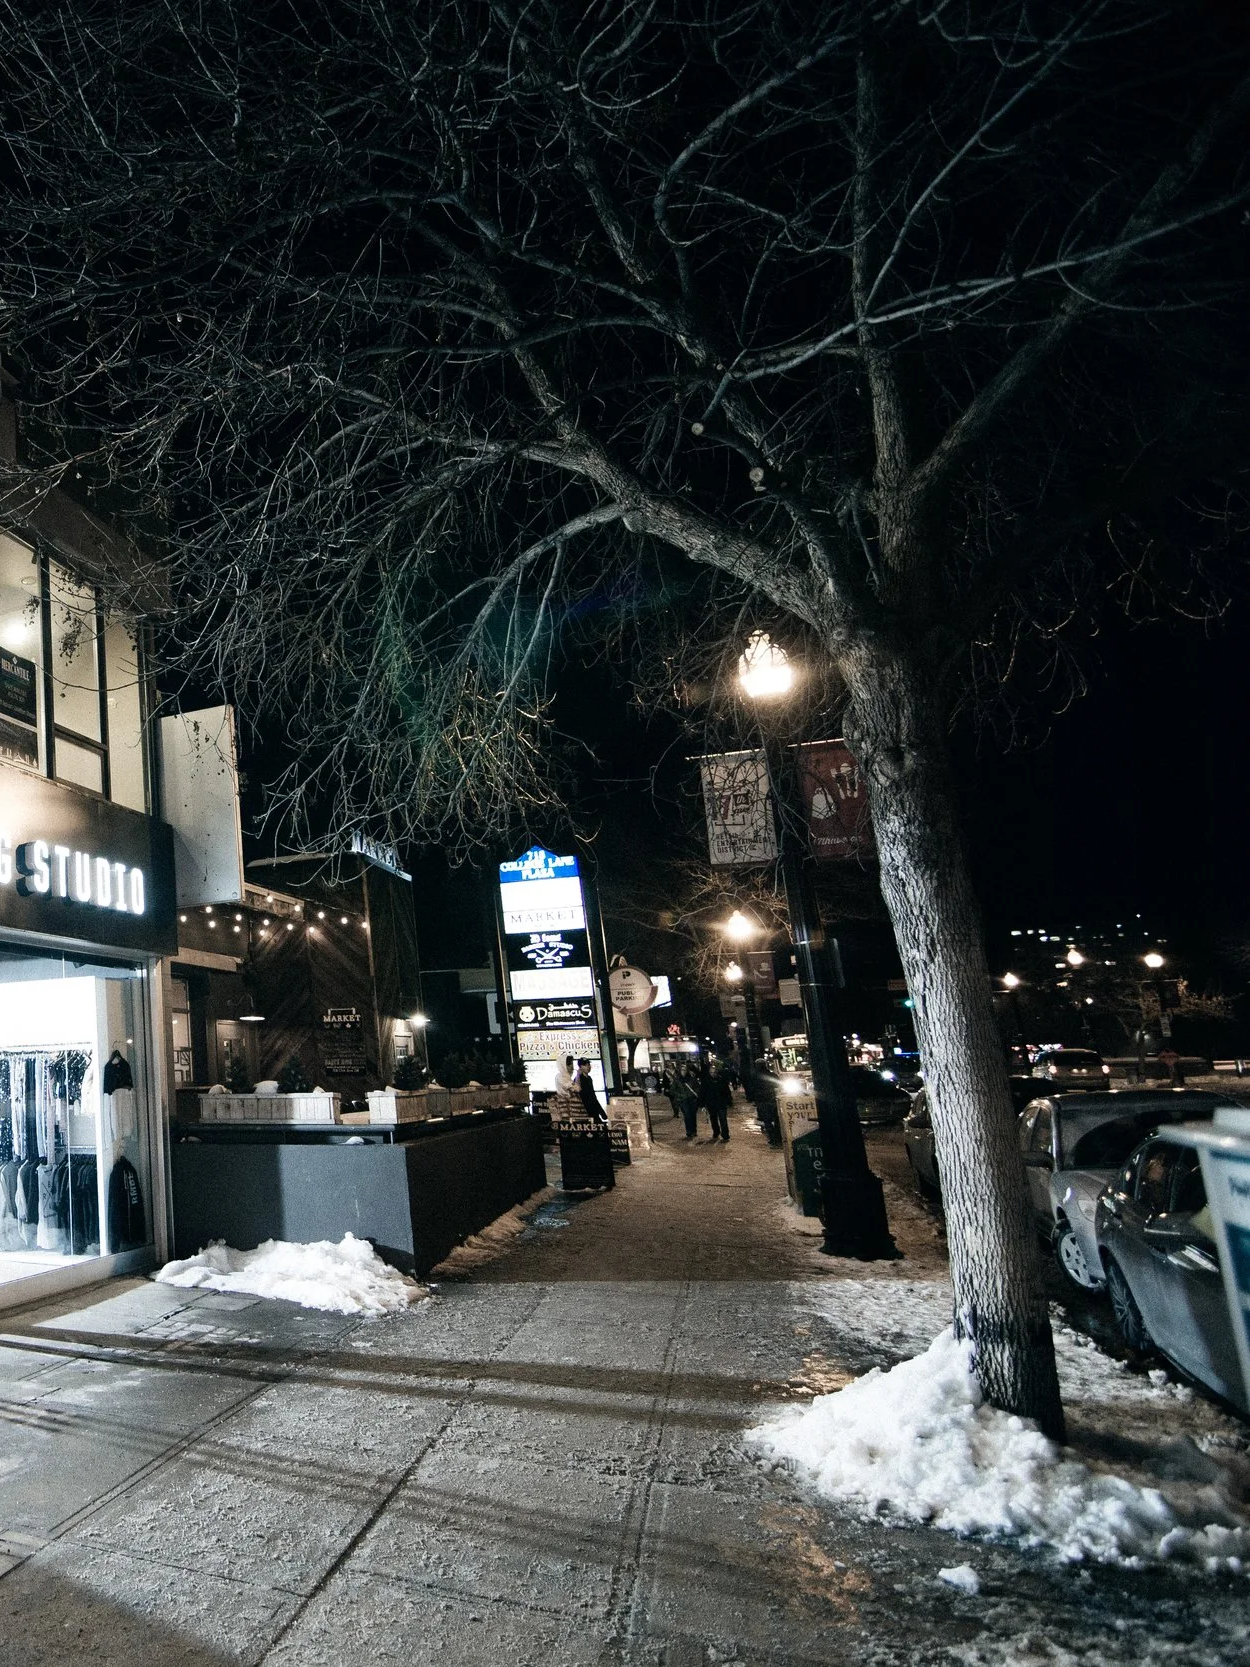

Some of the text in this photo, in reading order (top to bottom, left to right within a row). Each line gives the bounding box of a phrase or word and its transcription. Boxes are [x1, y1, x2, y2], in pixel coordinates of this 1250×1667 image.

[27, 840, 146, 915] STUDIO
[521, 867, 555, 880] PLAZA
[511, 910, 577, 924] MARKET
[323, 1014, 361, 1022] MARKET
[539, 1031, 577, 1041] Express
[519, 1041, 546, 1051] Pizza
[558, 1040, 600, 1050] Chicken
[786, 1102, 815, 1110] Start
[560, 1123, 605, 1131] MARKET
